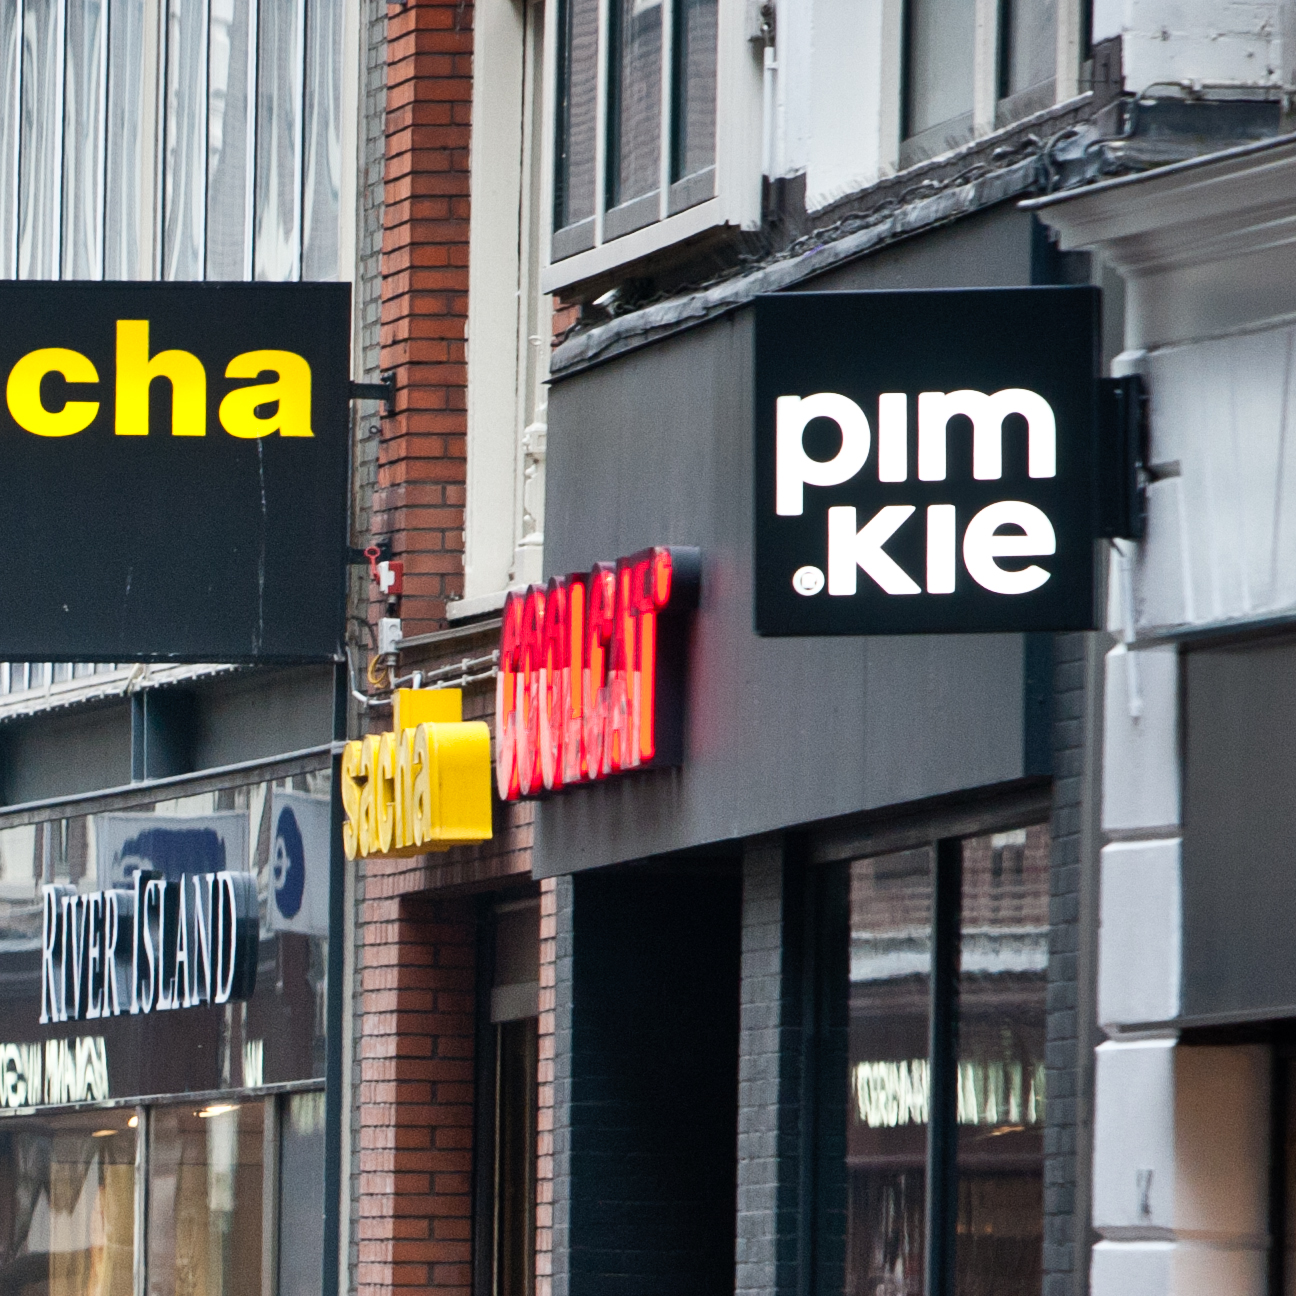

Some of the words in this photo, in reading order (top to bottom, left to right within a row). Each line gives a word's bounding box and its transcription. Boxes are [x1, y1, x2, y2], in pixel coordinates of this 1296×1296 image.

[775, 387, 1057, 516] pim
[341, 688, 436, 862] sacha
[39, 883, 121, 1025] RIVER
[129, 869, 237, 1015] ISLAND
